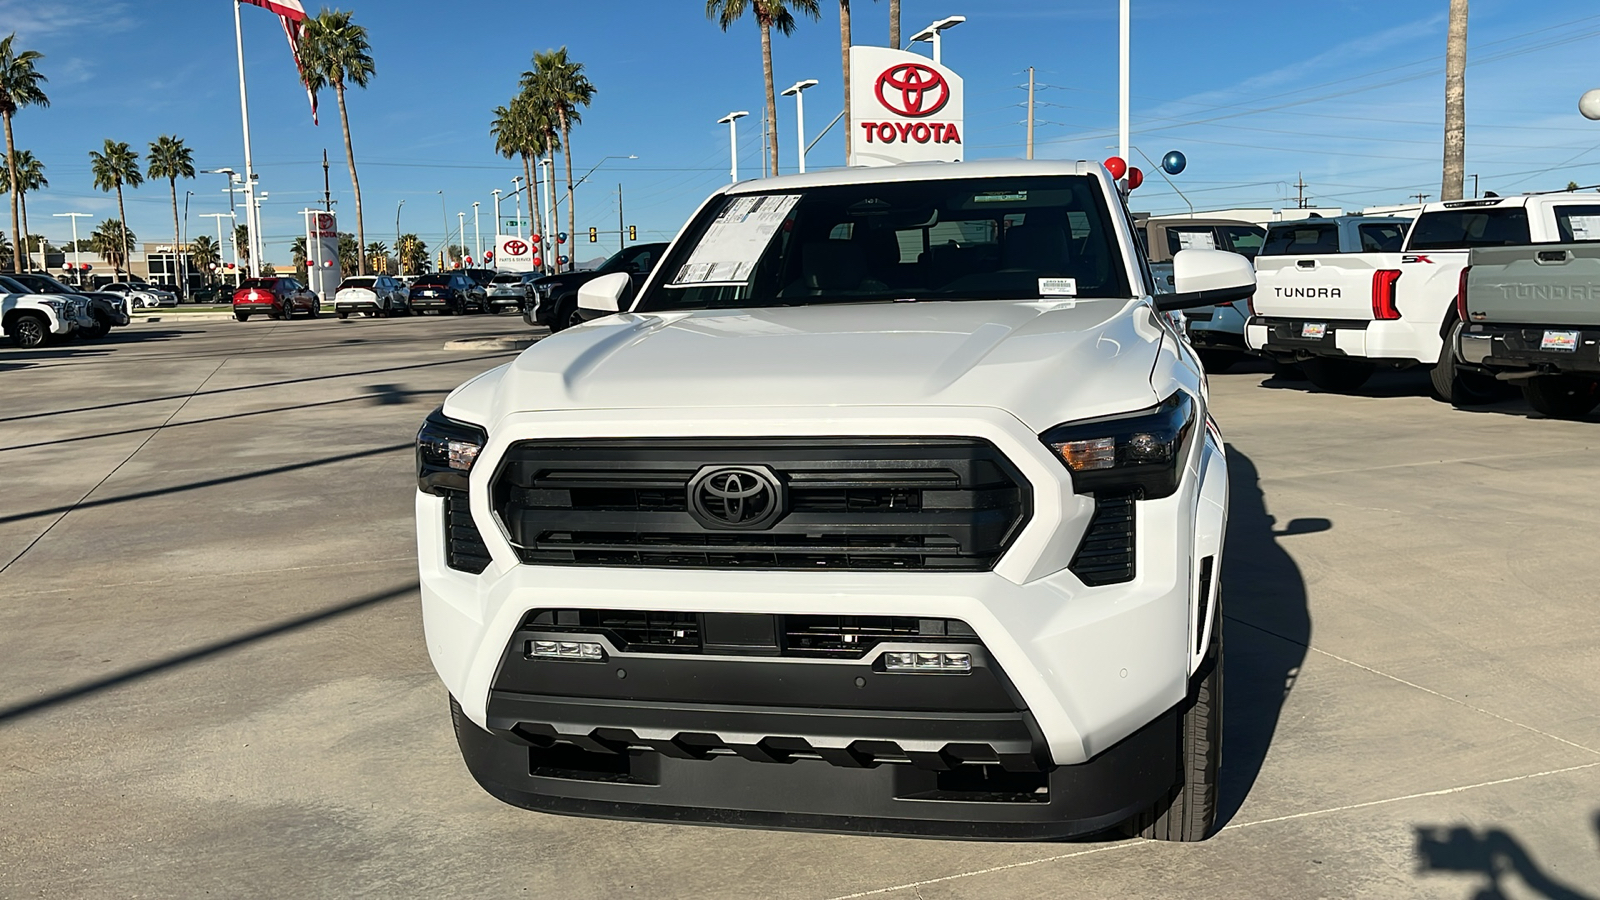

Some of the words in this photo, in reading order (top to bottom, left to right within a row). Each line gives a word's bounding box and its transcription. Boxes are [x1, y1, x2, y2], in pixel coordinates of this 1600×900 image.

[861, 122, 962, 144] TOYOTA
[310, 230, 337, 238] TYOTA
[1274, 287, 1341, 298] TUNDRA
